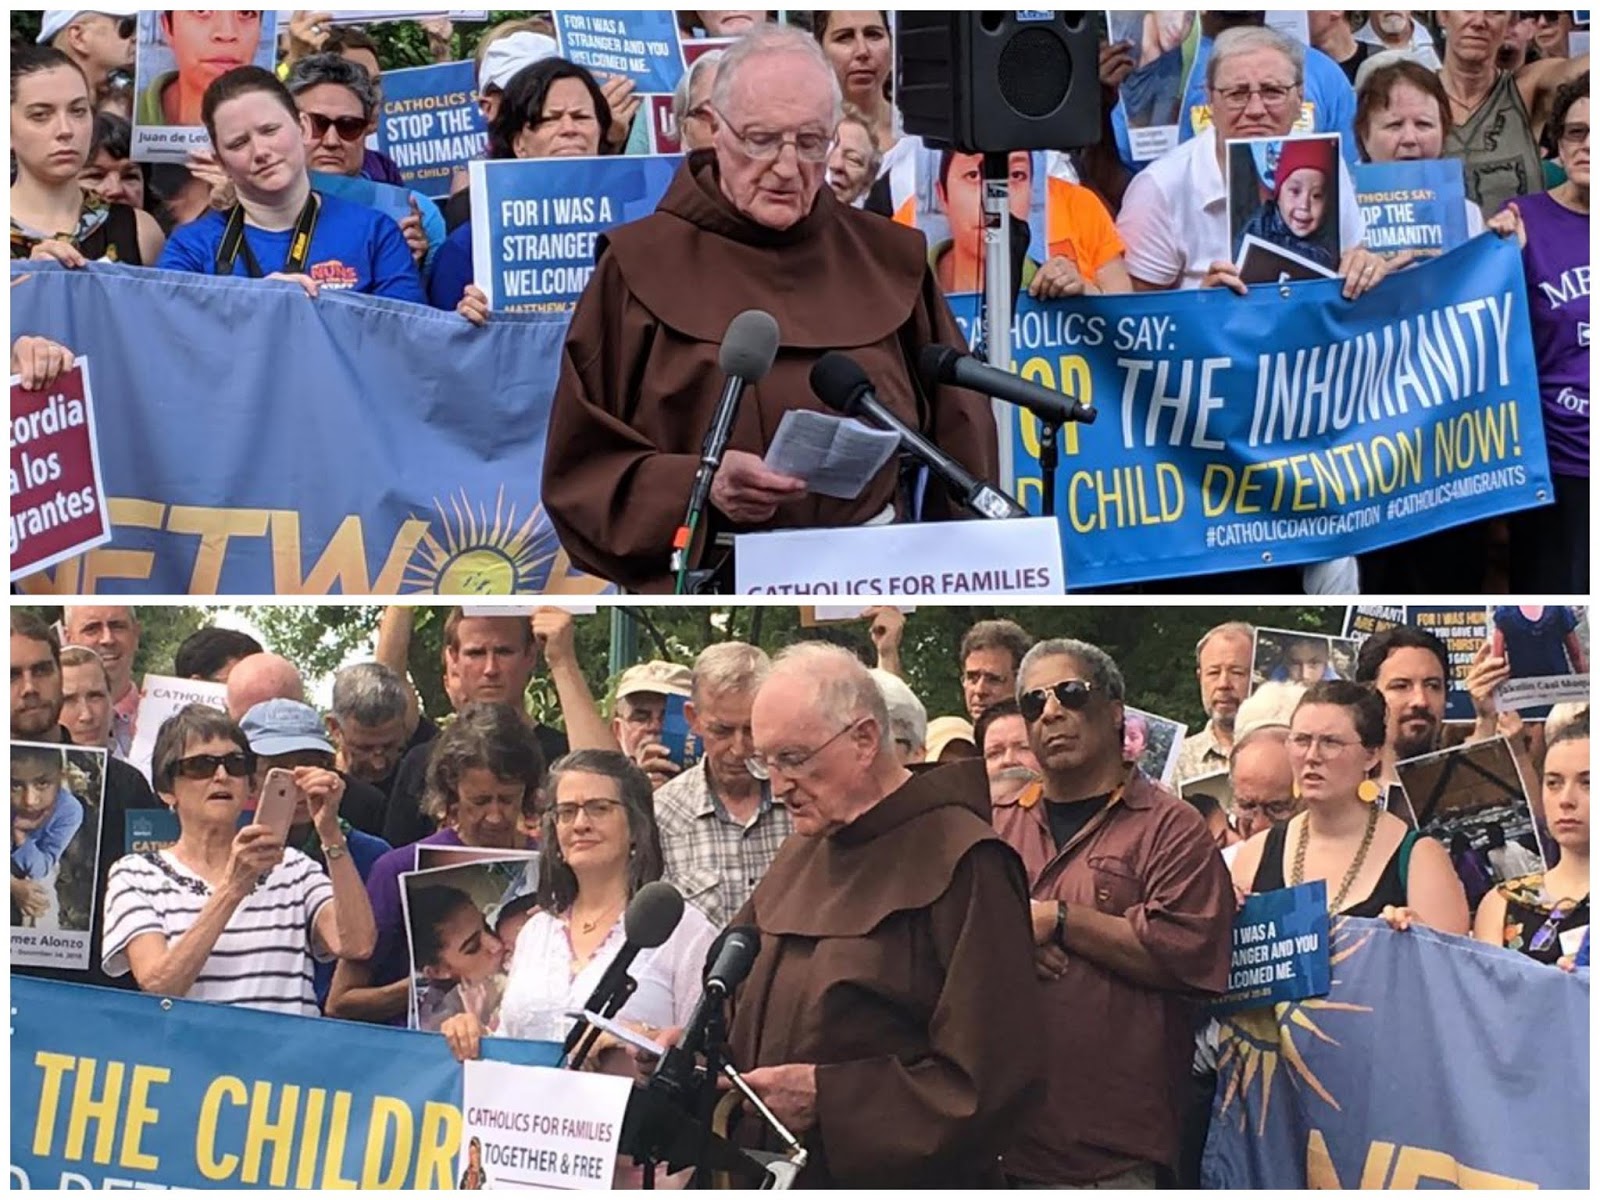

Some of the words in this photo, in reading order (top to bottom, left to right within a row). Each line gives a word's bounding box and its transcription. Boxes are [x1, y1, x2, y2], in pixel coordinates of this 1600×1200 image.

[563, 14, 585, 29] FOR
[591, 18, 616, 34] WAS
[618, 21, 627, 35] A
[567, 32, 622, 52] STRANGER
[624, 39, 645, 55] AND
[646, 42, 669, 56] YOU
[570, 50, 628, 71] WELCOMED
[384, 93, 466, 114] CATHOLICS
[138, 132, 167, 143] Juan
[170, 132, 186, 143] de
[386, 113, 434, 142] STOP
[437, 107, 474, 135] THE
[1357, 191, 1409, 203] THOLICS
[502, 200, 538, 227] FOR
[542, 201, 549, 226] I
[553, 197, 595, 225] WAS
[599, 197, 612, 222] A
[1361, 205, 1382, 225] OP
[1385, 203, 1415, 223] THE
[1362, 224, 1442, 248] HUMANITY!
[503, 266, 596, 297] WELCOM
[1113, 316, 1177, 351] SAY:
[1008, 354, 1092, 459] OP
[1117, 356, 1232, 450] THE
[1249, 292, 1513, 448] INHUMANITY
[21, 452, 62, 490] los
[1069, 462, 1185, 533] CHILD
[1202, 427, 1422, 518] DETENTION
[1434, 400, 1523, 479] NOW!
[1206, 504, 1381, 549] #CATHOLICDAYOFACTION
[1386, 464, 1527, 521] #CATHOLICS4MIGRANTS
[889, 574, 934, 595] FOR
[941, 567, 1051, 594] FAMILIES
[1417, 613, 1436, 626] FOR
[11, 935, 37, 946] mez
[40, 935, 84, 949] Alonzo
[1240, 923, 1266, 945] WAS
[1267, 920, 1277, 940] A
[1231, 944, 1269, 968] ANGER
[1271, 939, 1294, 960] AND
[1295, 933, 1319, 955] YOU
[1228, 965, 1274, 990] LCOMED
[32, 1051, 172, 1171] THE
[195, 1075, 465, 1190] CHILDR
[467, 1106, 530, 1133] CATHOLICS
[532, 1114, 559, 1137] FOR
[561, 1117, 613, 1143] FAMILIES
[484, 1142, 558, 1174] TOGETHER
[559, 1152, 571, 1176] &
[572, 1153, 604, 1180] FREE
